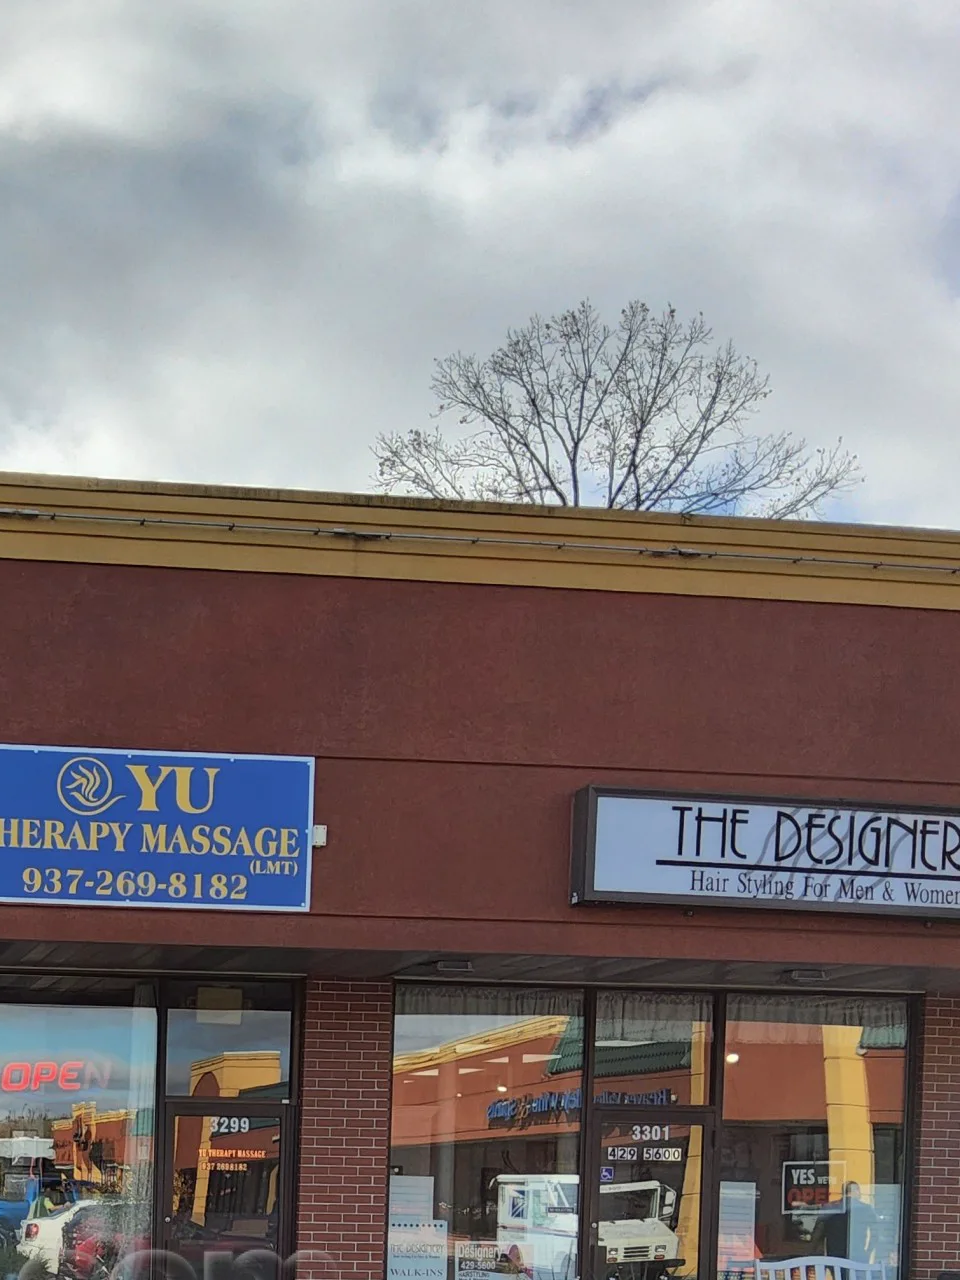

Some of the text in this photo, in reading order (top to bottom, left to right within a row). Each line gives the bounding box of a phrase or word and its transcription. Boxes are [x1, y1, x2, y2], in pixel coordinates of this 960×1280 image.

[126, 764, 220, 814] YU
[140, 823, 300, 857] MASSAGE
[672, 806, 749, 859] THE
[249, 860, 299, 877] (LMT)
[22, 867, 248, 900] 937-269-8182
[690, 870, 730, 893] Hair
[737, 872, 794, 899] Styling
[803, 876, 831, 898] For
[839, 878, 875, 900] Men
[882, 882, 895, 901] &
[1, 1061, 112, 1091] OPEN
[210, 1116, 249, 1132] 3299
[632, 1125, 669, 1140] 3301
[208, 1149, 236, 1157] THERAPY
[237, 1149, 266, 1158] MASSAGE
[608, 1147, 681, 1161] 429 5600
[791, 1168, 815, 1185] YES
[458, 1244, 501, 1261] Designery
[390, 1269, 443, 1277] WALK-INS
[460, 1261, 496, 1270] 429-5600
